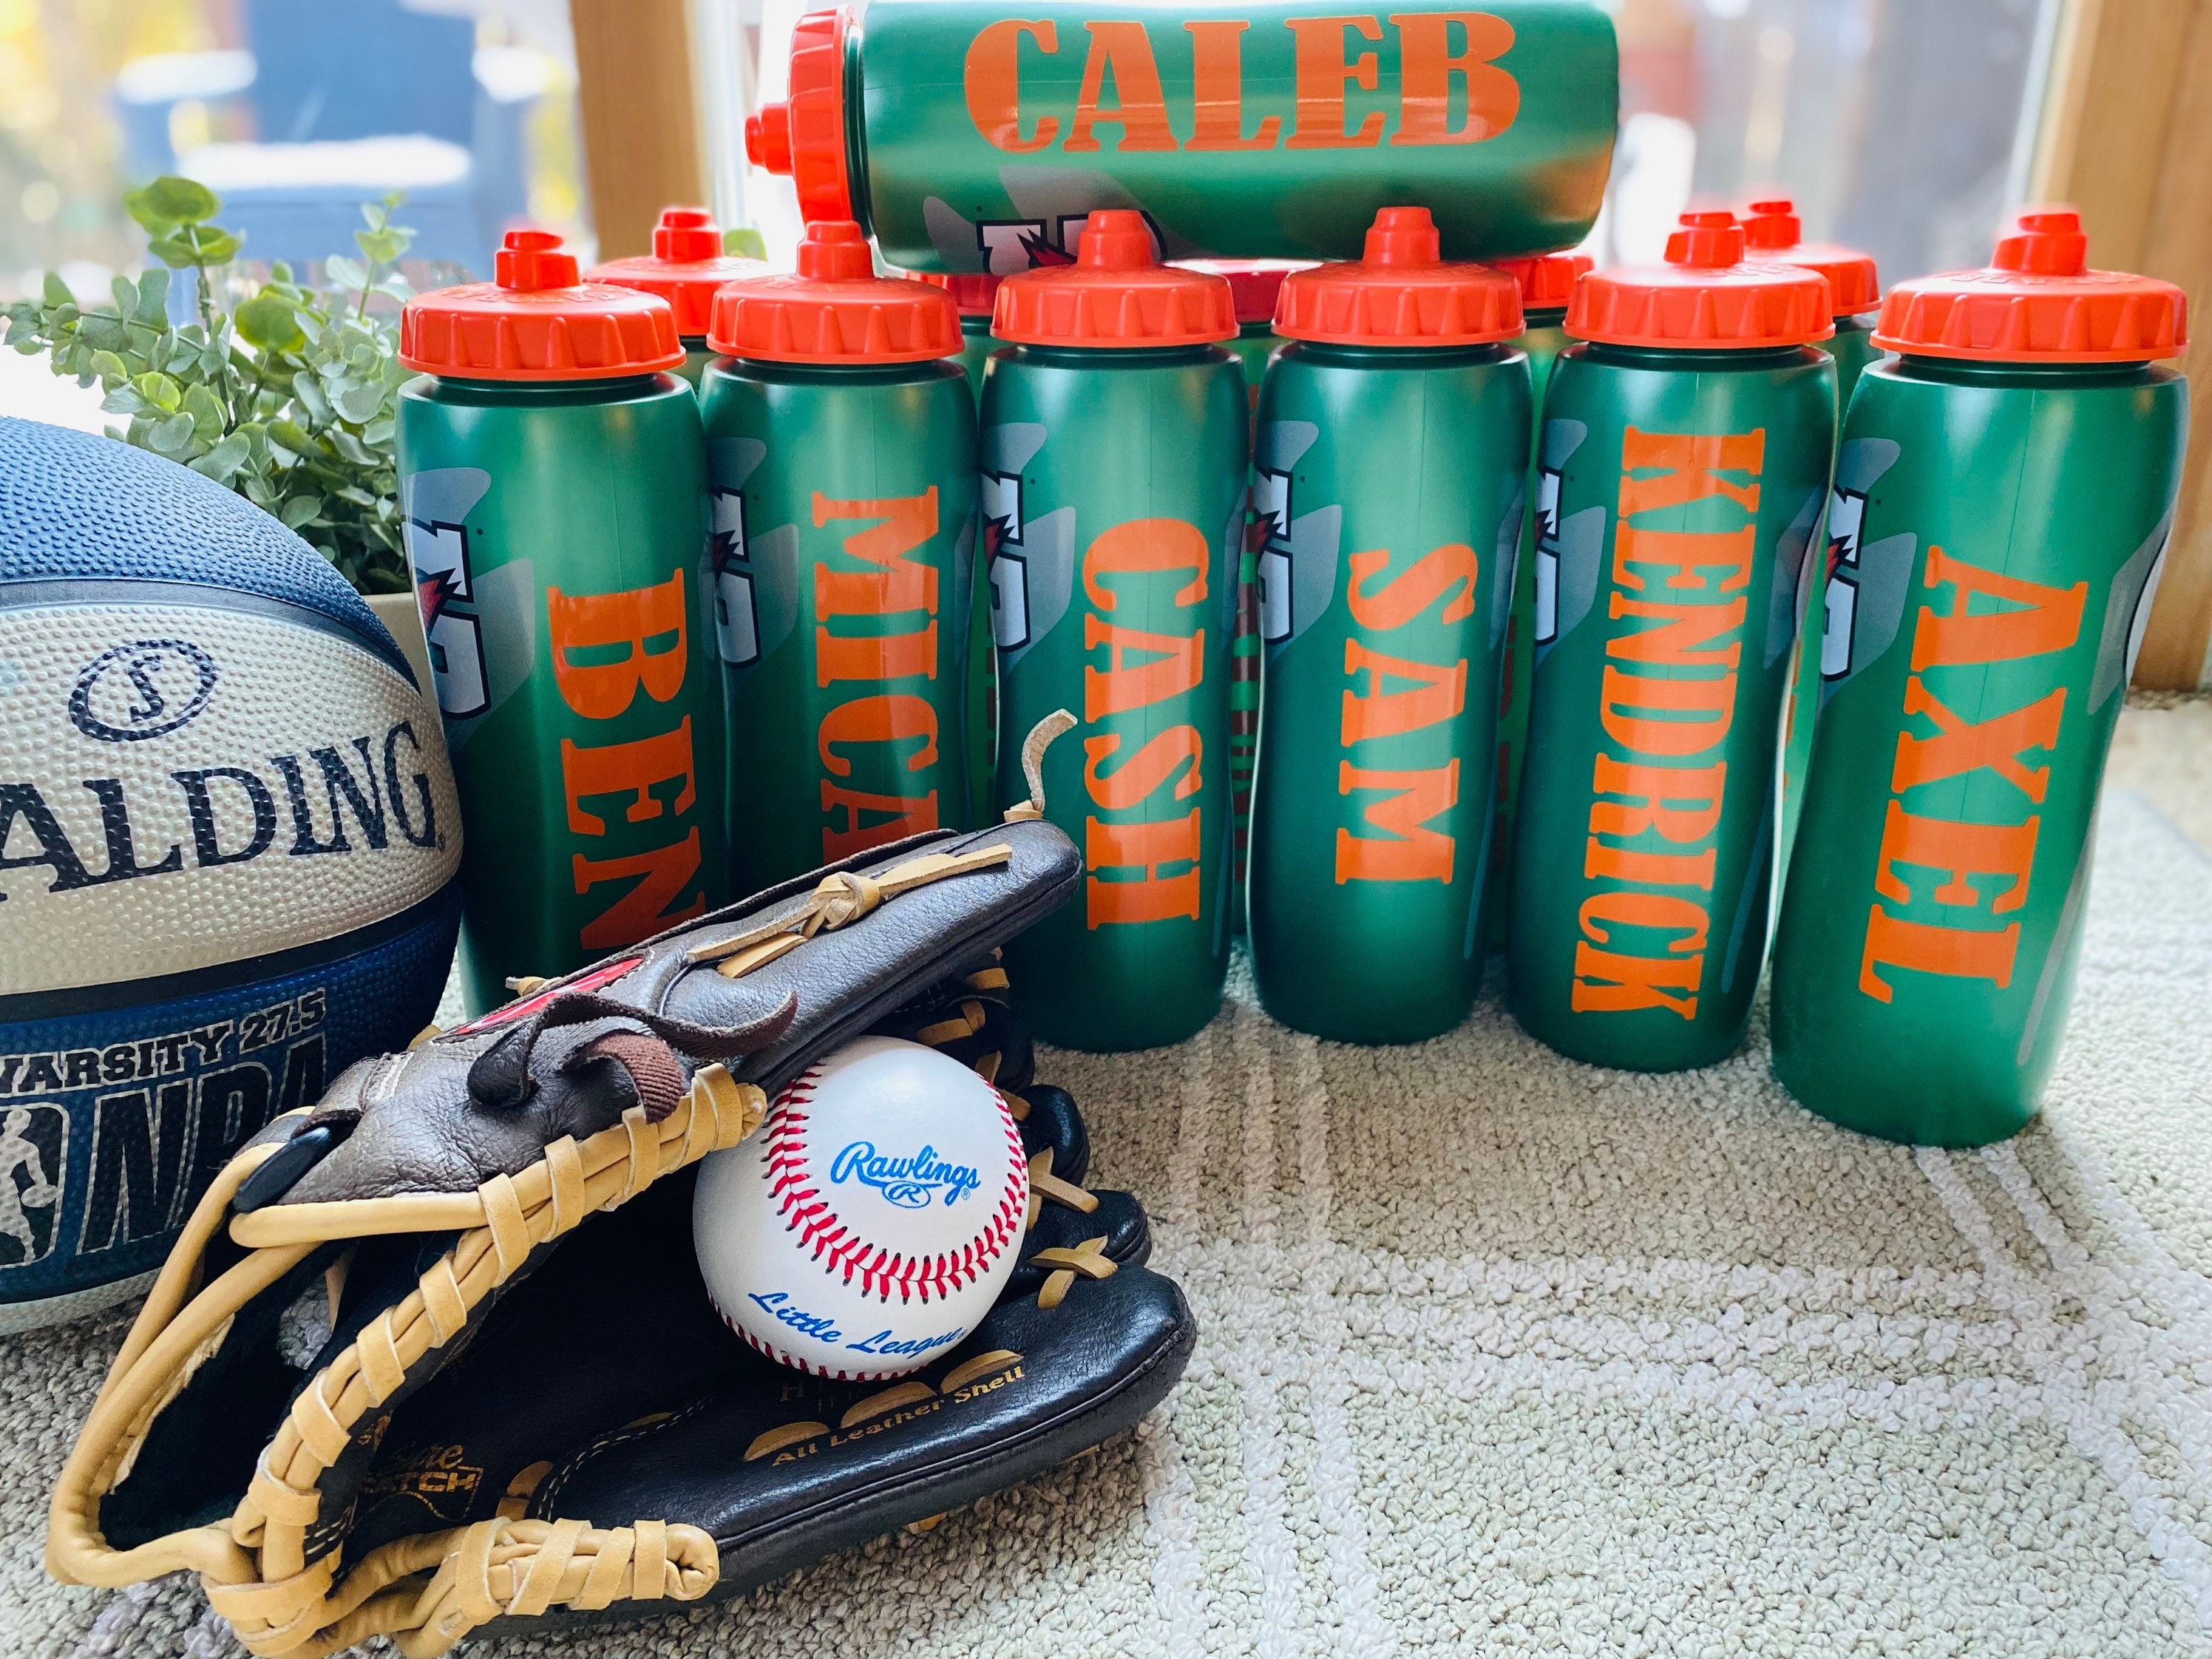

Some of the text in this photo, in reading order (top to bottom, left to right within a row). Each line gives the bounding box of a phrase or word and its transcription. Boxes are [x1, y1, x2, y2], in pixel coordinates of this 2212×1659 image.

[964, 12, 1521, 154] CALEB
[547, 567, 707, 950] BEN
[1083, 518, 1210, 931] CASH
[1334, 543, 1479, 886] SAM
[1571, 426, 1766, 1021] KENDRICK
[1859, 546, 2089, 1003] AXEL
[239, 987, 326, 1054] 27.5
[830, 1141, 981, 1207] Rawlings
[747, 1292, 964, 1360] Little League
[772, 1365, 1025, 1467] All Leather Shell
